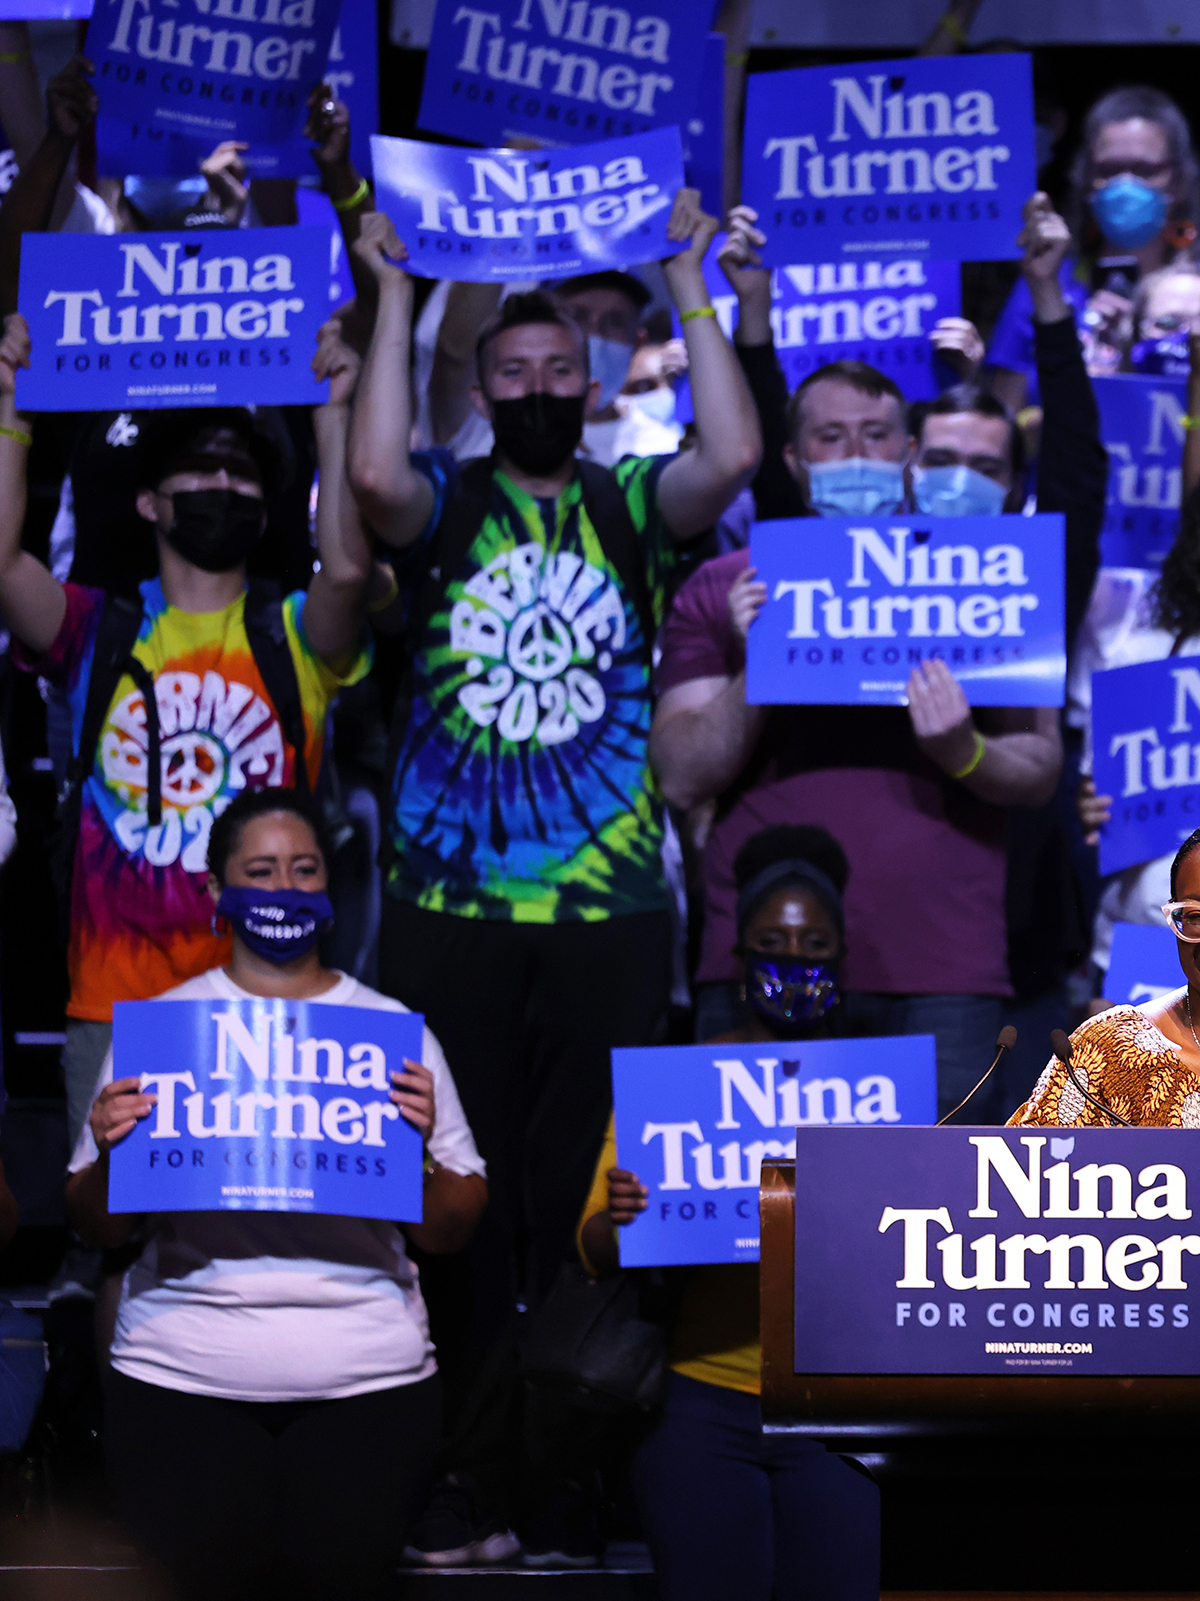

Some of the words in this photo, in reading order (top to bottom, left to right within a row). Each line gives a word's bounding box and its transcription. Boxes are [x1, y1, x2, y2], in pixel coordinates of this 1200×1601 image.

[88, 0, 316, 80] Turner
[453, 5, 674, 117] Turner
[828, 74, 999, 142] Nina
[466, 155, 648, 203] Nina
[763, 134, 1011, 200] Turner
[403, 183, 660, 239] Turner
[117, 242, 296, 297] Nina
[44, 289, 305, 346] Turner
[56, 353, 111, 373] FOR
[129, 346, 291, 370] CONGRESS
[846, 527, 1029, 588] Nina
[450, 541, 626, 661] BERNIE
[773, 578, 1040, 639] Turner
[786, 646, 845, 666] FOR
[457, 664, 606, 746] 2020
[209, 1012, 391, 1092] Nina
[140, 1070, 400, 1148] Turner
[713, 1058, 901, 1130] Nina
[149, 1148, 205, 1170] FOR
[223, 1149, 387, 1178] CONGRESS
[220, 1185, 315, 1200] NINATURNER.COM
[968, 1136, 1193, 1221] Nina
[660, 1201, 718, 1221] FOR
[896, 1302, 967, 1328] FOR
[987, 1302, 1191, 1329] CONGRESS
[984, 1342, 1093, 1355] NINATURNER.COM
